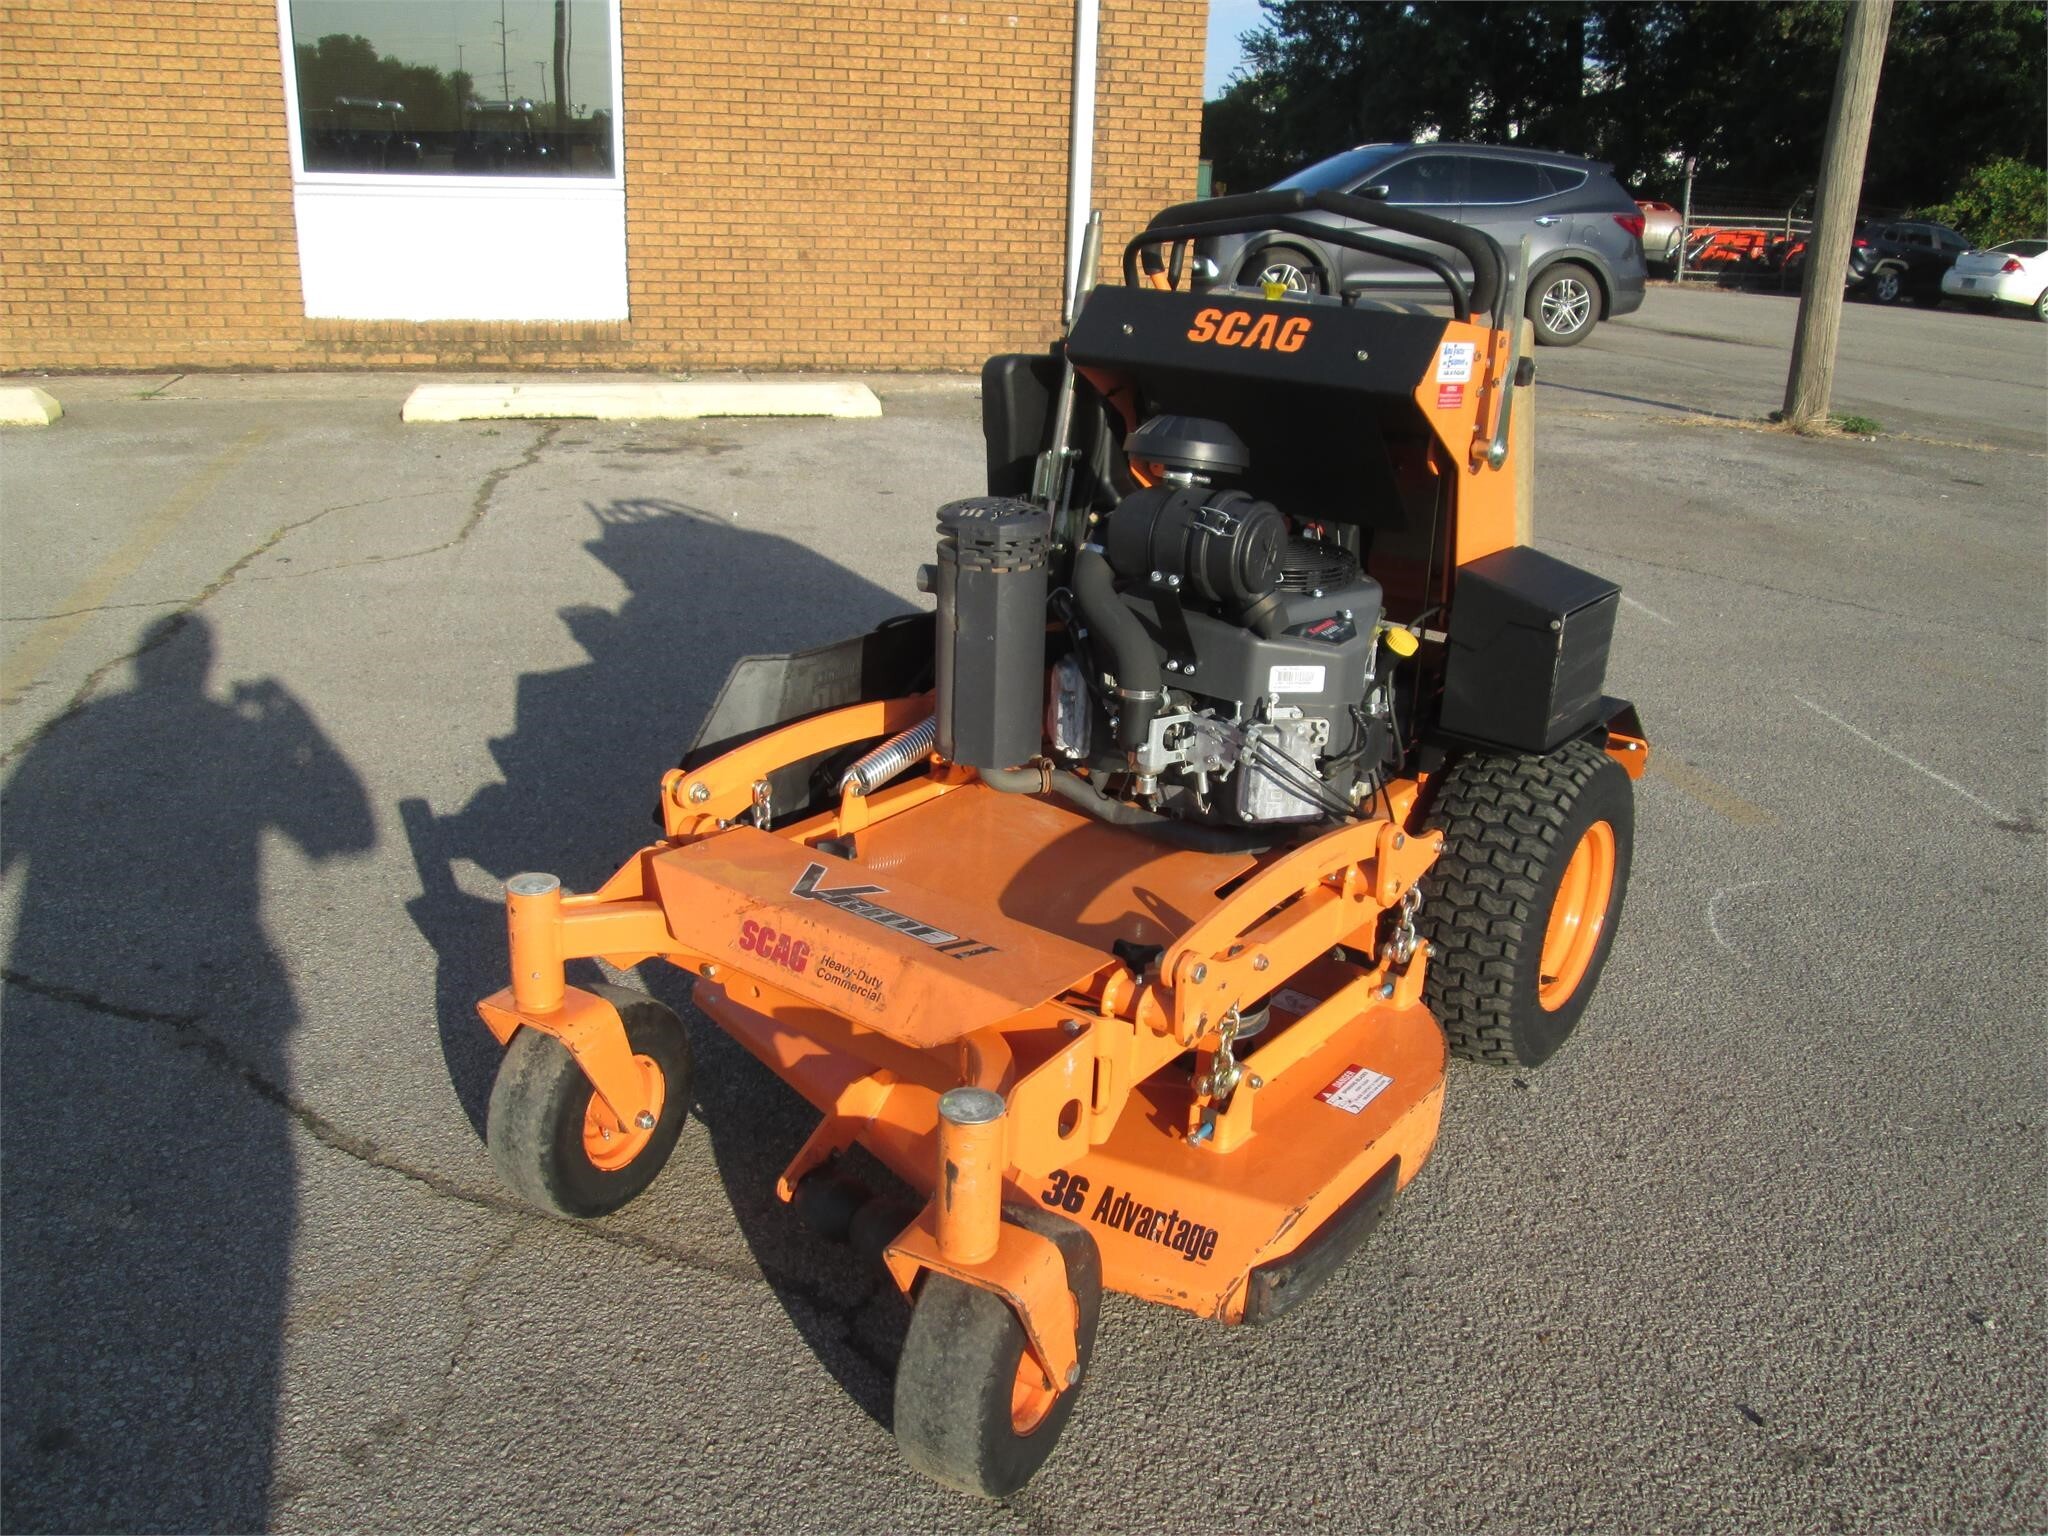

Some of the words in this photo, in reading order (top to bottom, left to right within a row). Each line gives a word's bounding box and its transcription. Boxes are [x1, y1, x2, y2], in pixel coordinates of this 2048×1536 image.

[1187, 308, 1312, 352] SCAG
[739, 919, 811, 973] SCAG
[816, 967, 882, 1003] Commercial
[820, 954, 883, 989] Heavy-Duty
[1041, 1168, 1091, 1215] 36
[1090, 1185, 1219, 1262] Advantage
